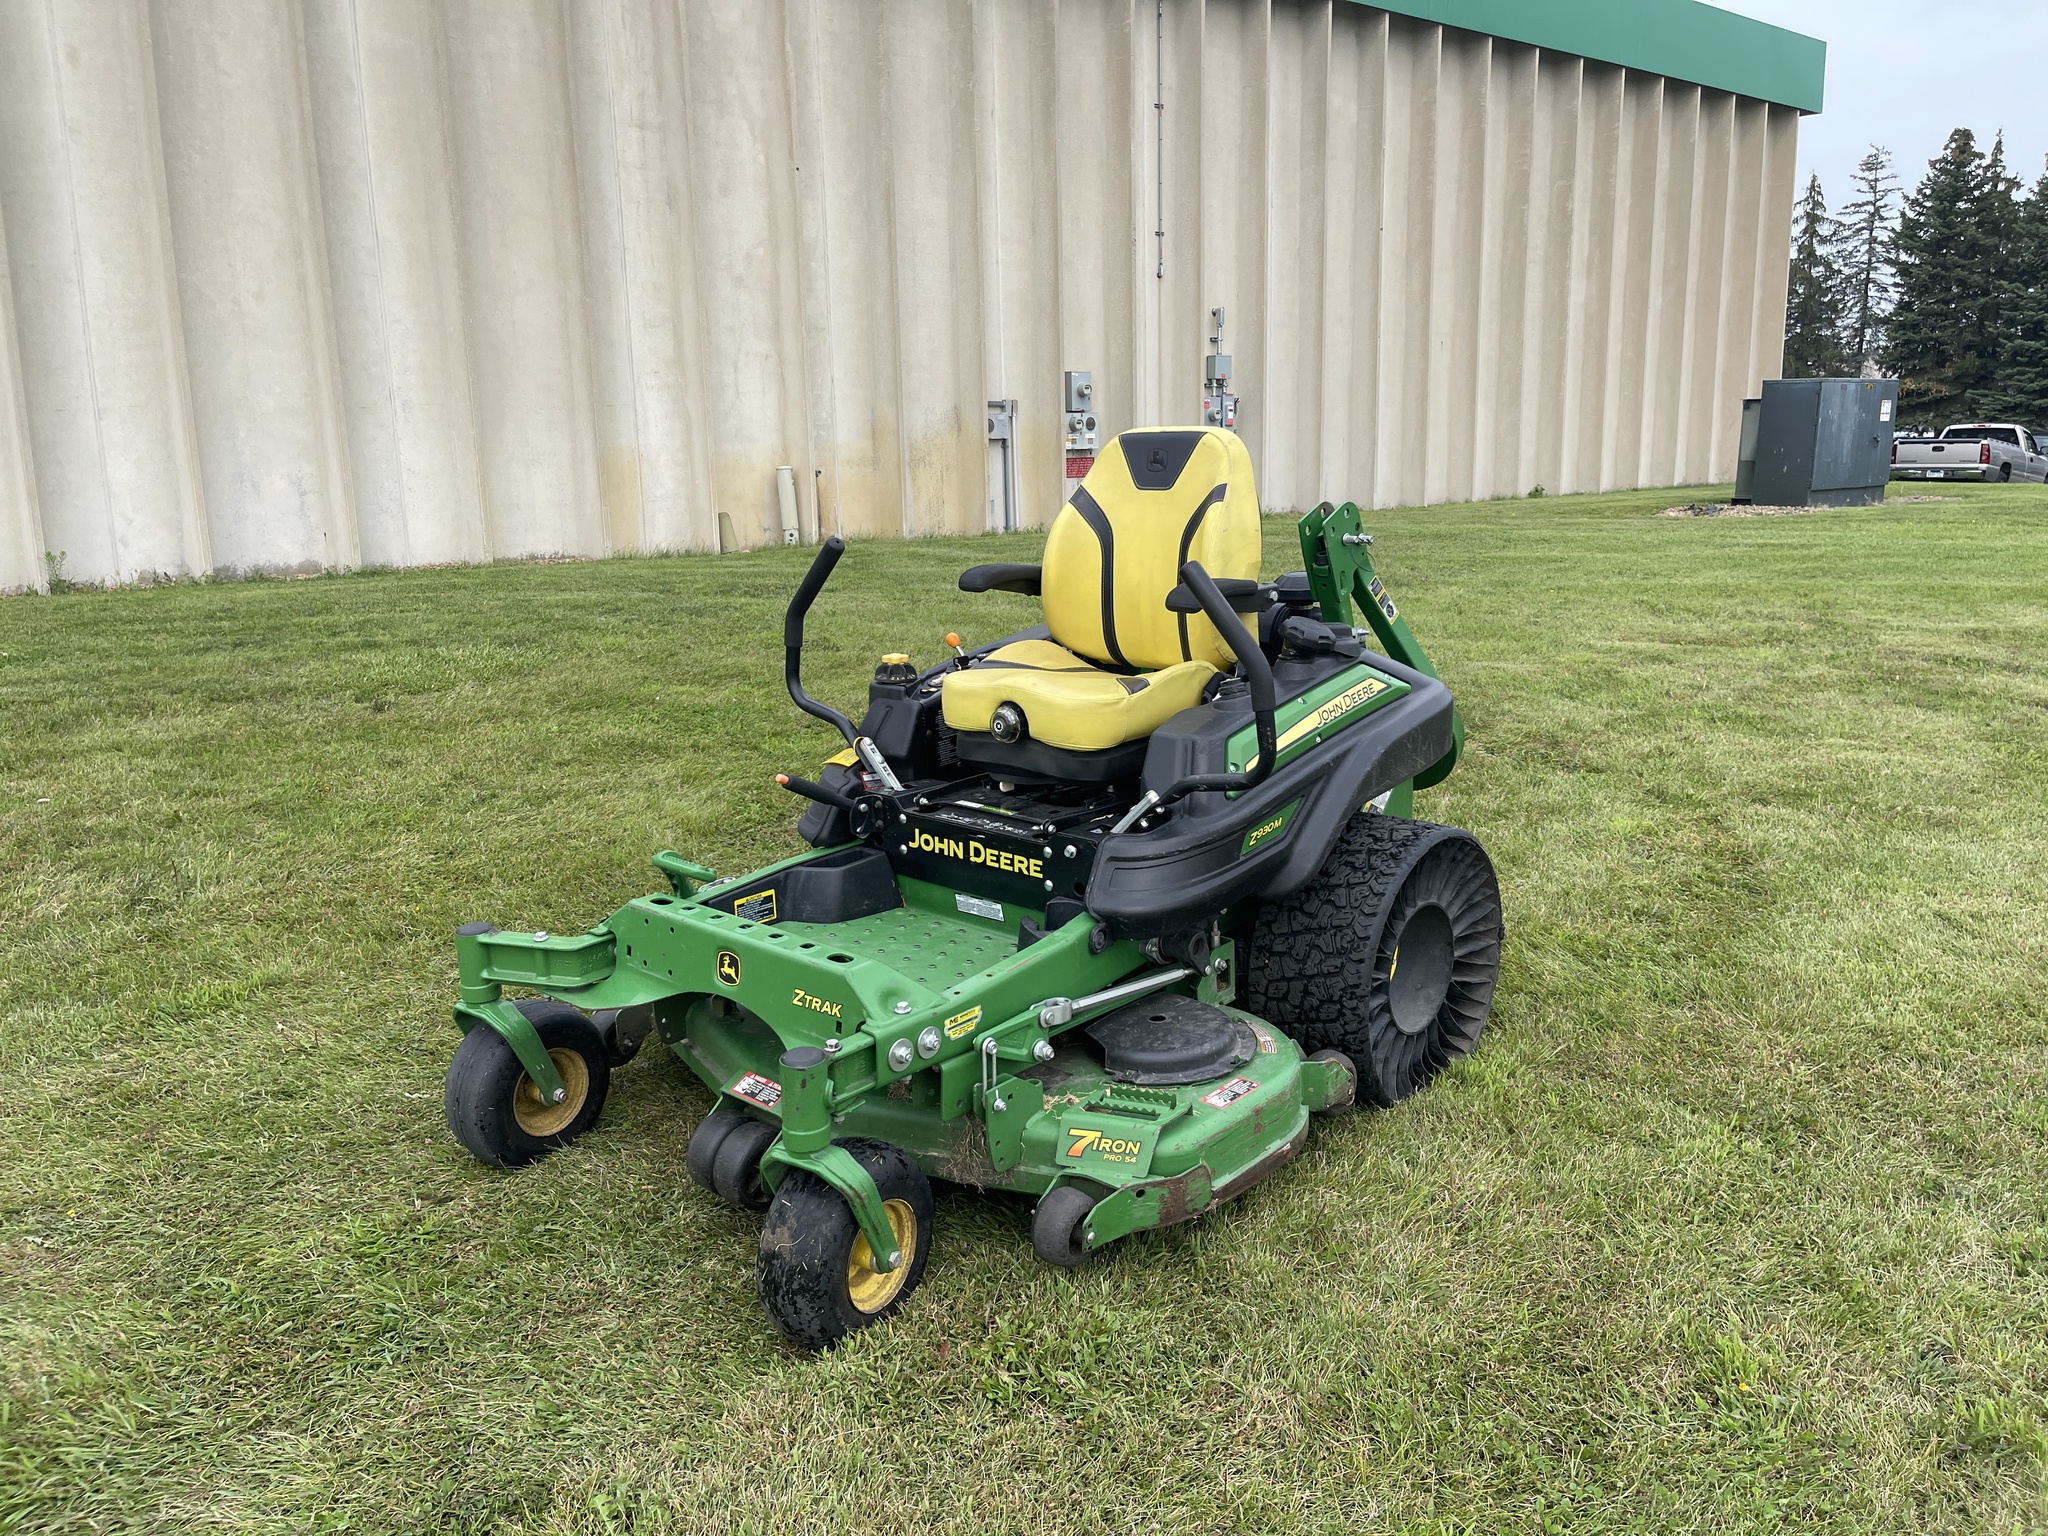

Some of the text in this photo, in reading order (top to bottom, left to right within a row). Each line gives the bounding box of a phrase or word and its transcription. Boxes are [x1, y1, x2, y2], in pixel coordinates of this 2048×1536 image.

[1317, 683, 1376, 726] JOHN DEERE
[1249, 817, 1283, 846] Z930M
[908, 828, 1044, 879] JOHN DEERE
[792, 988, 843, 1018] ZTRAK
[1103, 1153, 1122, 1162] PRO
